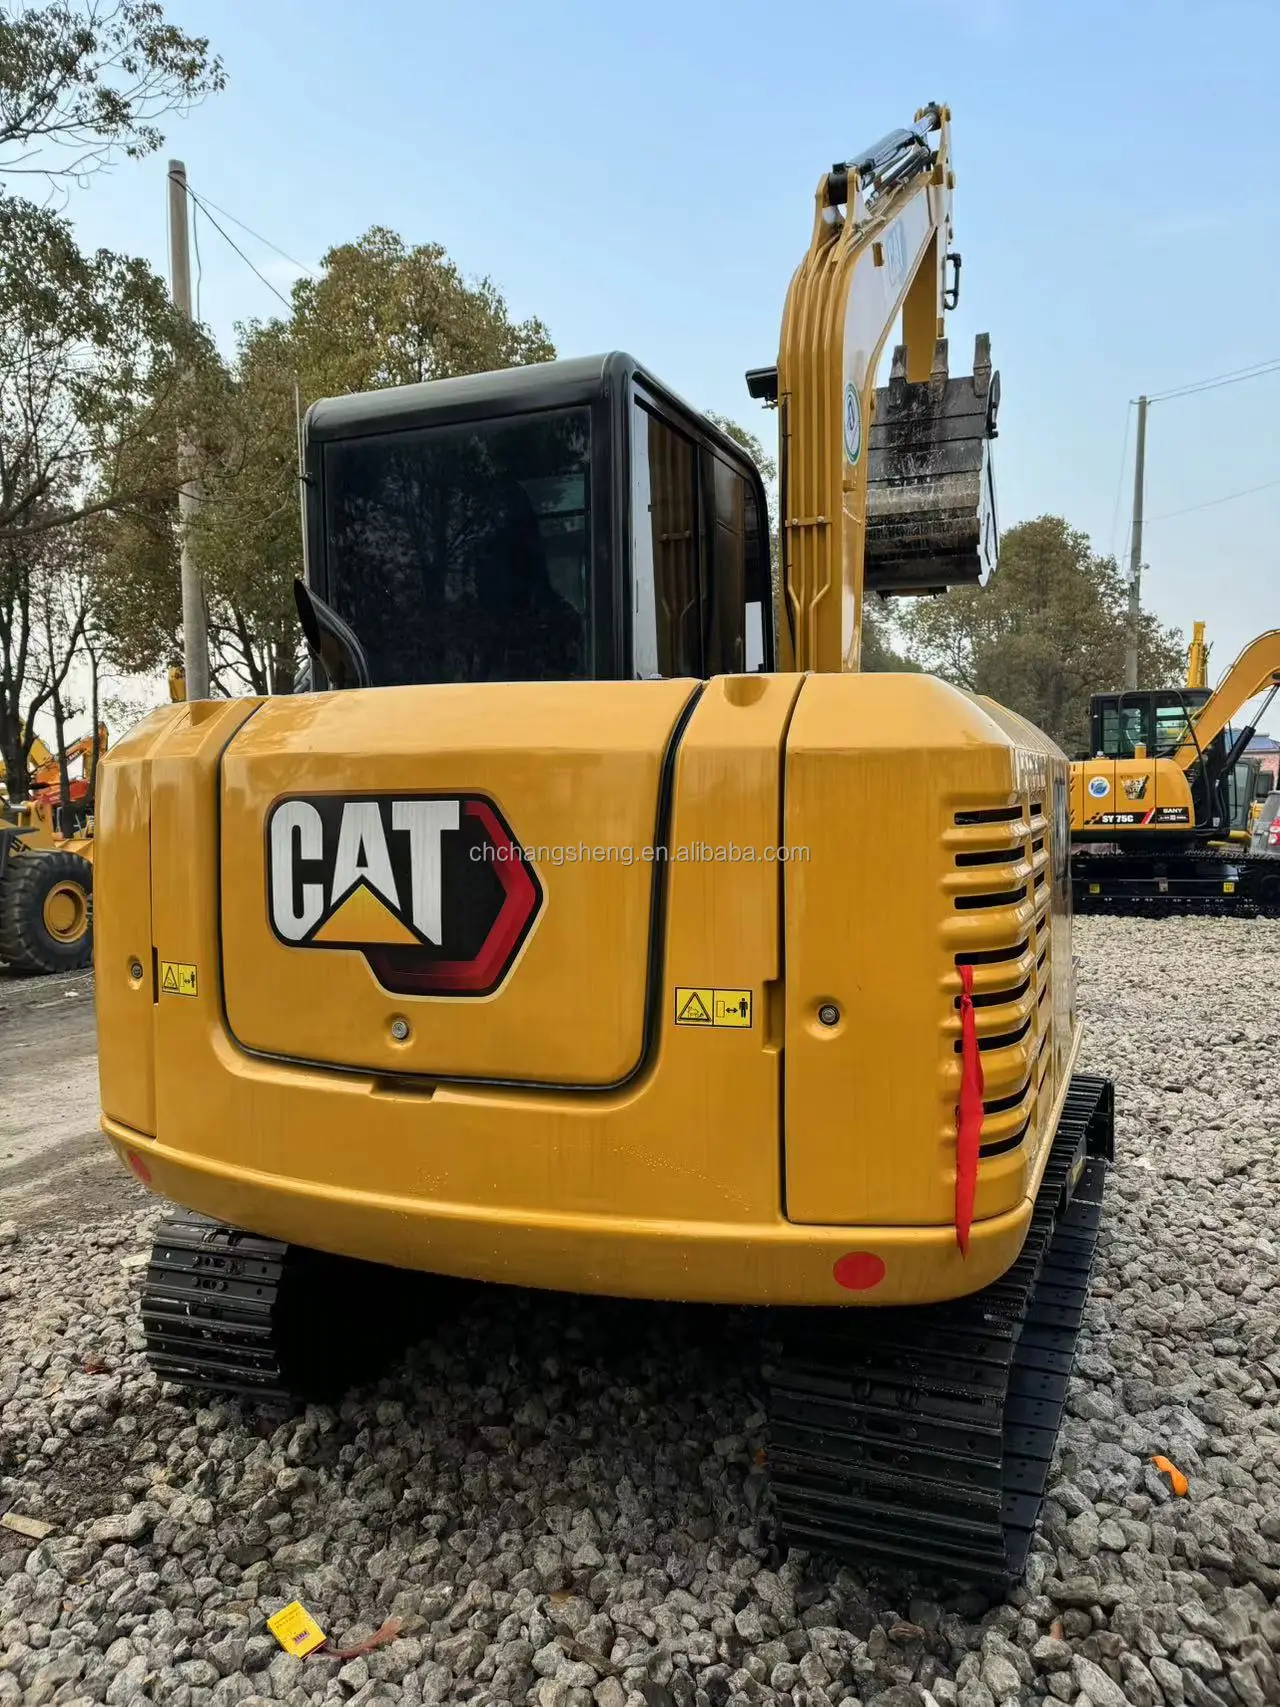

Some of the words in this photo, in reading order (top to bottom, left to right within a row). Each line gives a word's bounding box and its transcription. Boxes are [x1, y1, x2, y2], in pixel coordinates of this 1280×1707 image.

[1102, 815, 1115, 823] SY
[1116, 815, 1134, 823] 75C
[271, 800, 460, 946] CAT
